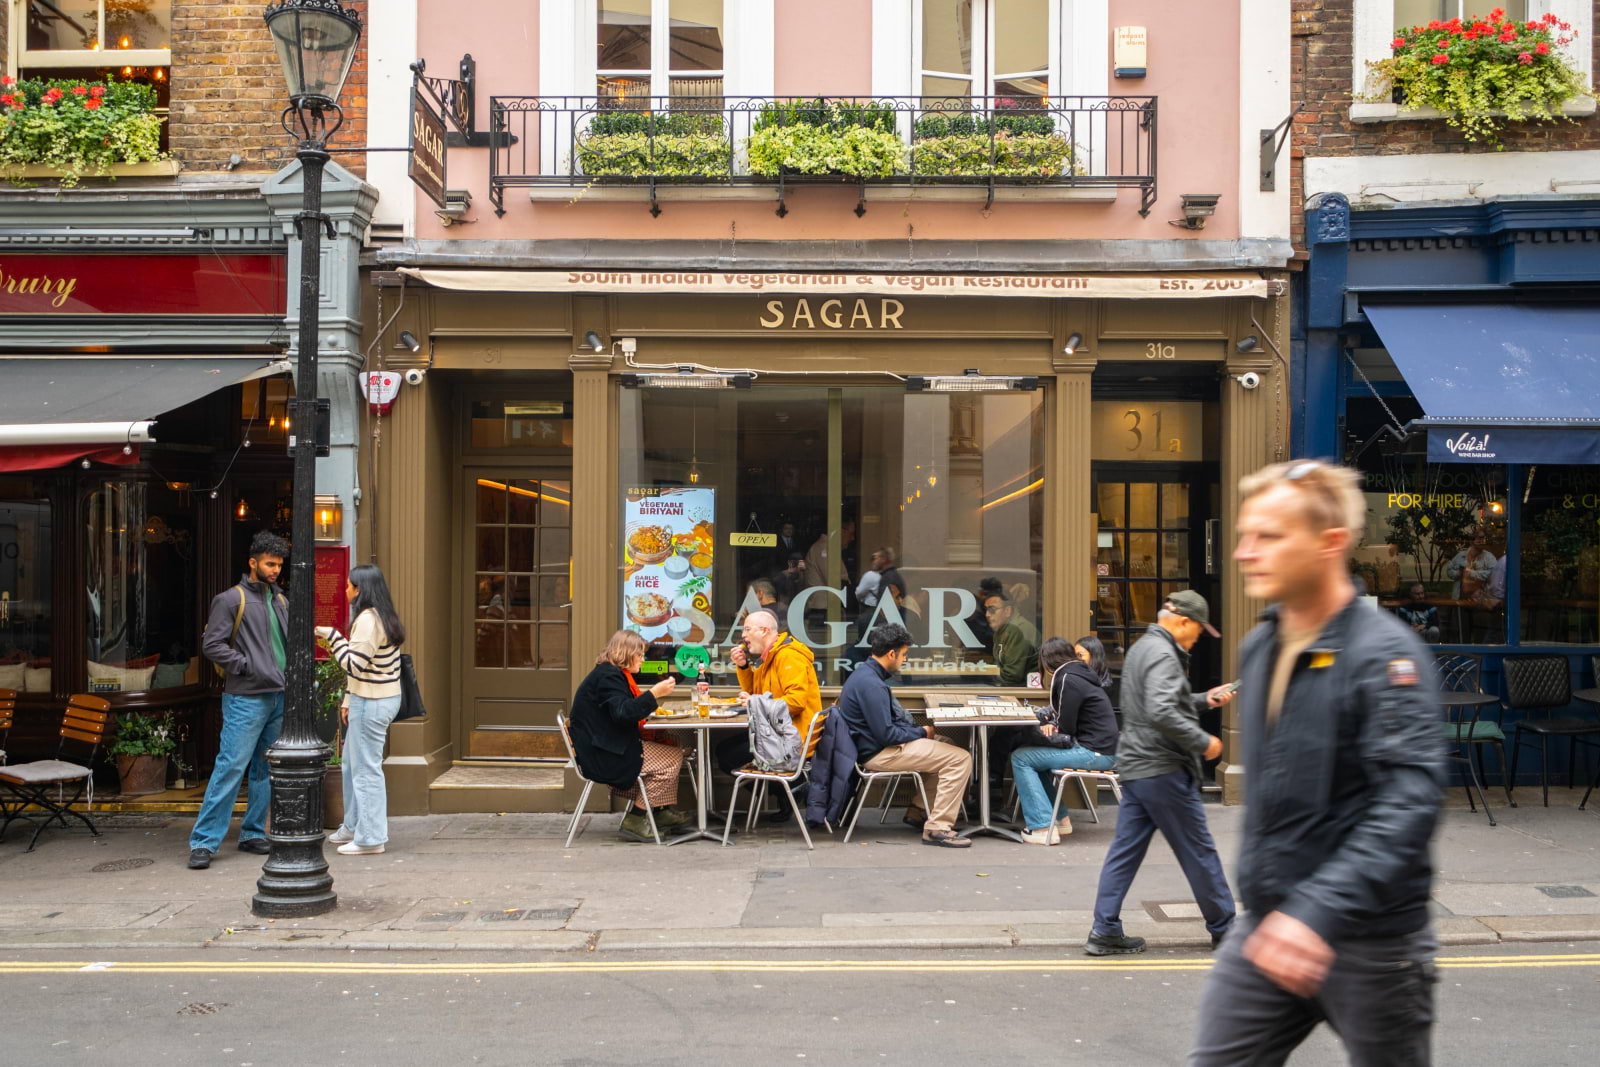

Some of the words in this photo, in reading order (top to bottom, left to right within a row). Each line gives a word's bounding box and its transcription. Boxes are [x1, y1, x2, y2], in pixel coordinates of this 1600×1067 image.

[413, 111, 444, 168] SAGAR
[0, 264, 77, 308] rury
[855, 275, 873, 285] &
[1203, 279, 1254, 291] 200
[759, 298, 906, 329] SAGAR
[1145, 343, 1176, 359] 31a
[1387, 493, 1422, 509] FOR
[1428, 493, 1464, 508] HIRE
[737, 535, 770, 544] OPEN
[635, 580, 659, 588] RICE
[833, 658, 988, 673] Raurant
